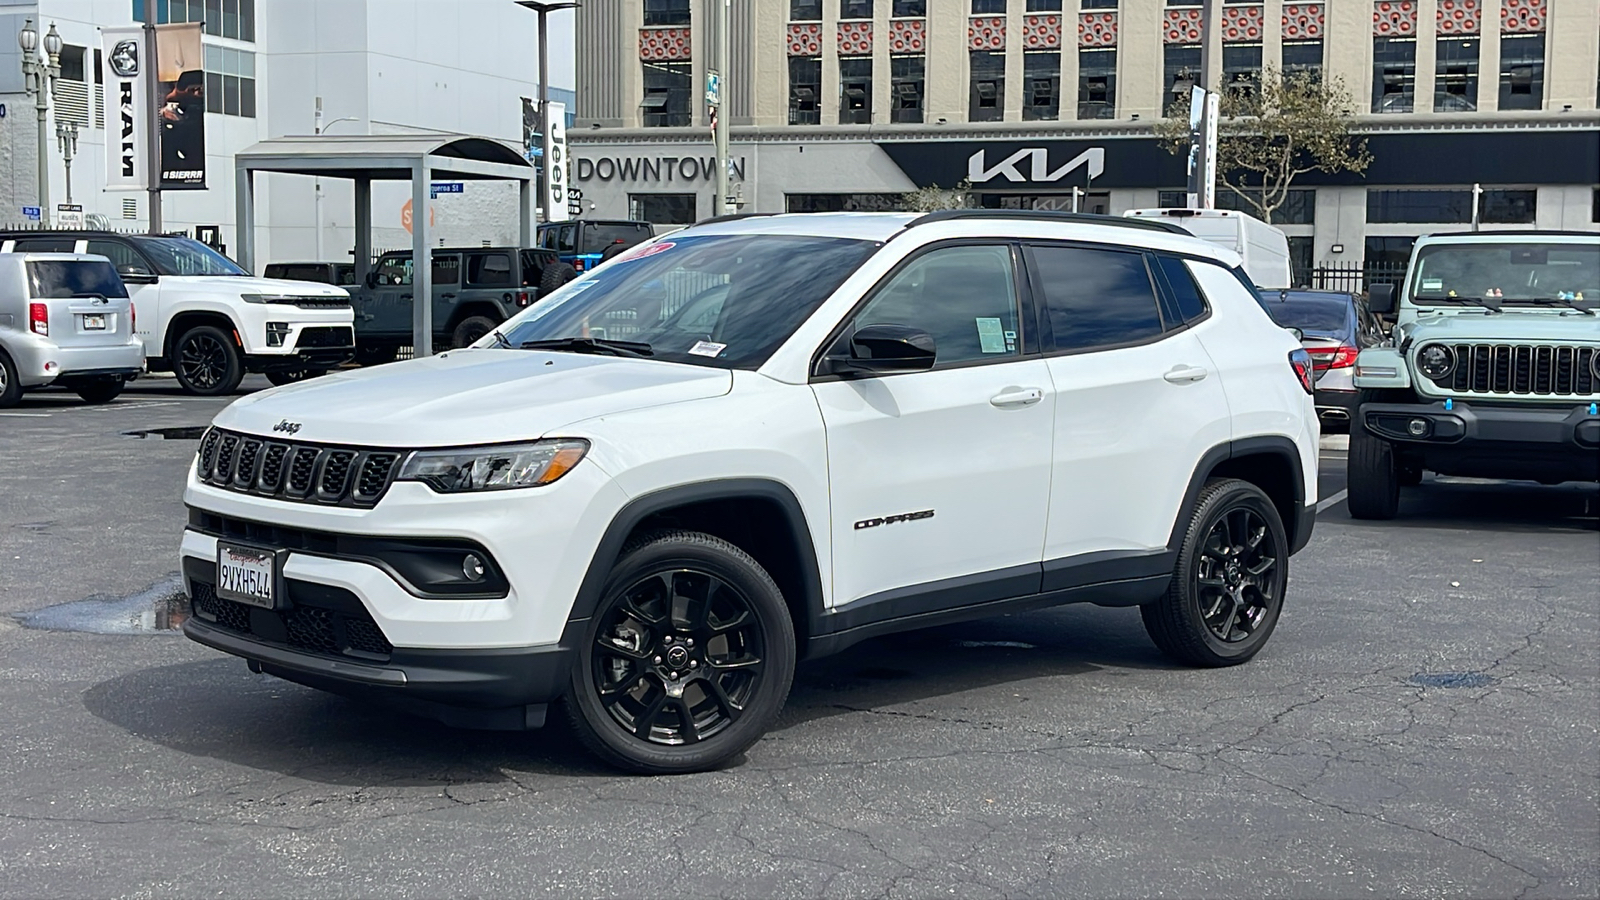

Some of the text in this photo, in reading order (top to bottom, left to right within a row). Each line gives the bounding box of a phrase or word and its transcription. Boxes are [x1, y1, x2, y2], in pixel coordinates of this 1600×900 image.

[120, 82, 133, 176] RAM
[169, 171, 203, 179] SIERRA
[551, 123, 563, 203] Jeep
[578, 157, 745, 181] DOWNTOWN
[969, 147, 1104, 182] KIA
[431, 184, 459, 193] gueroa St
[273, 419, 302, 436] Jeep
[854, 509, 935, 530] COMPASS
[222, 564, 271, 599] 9VXH544
